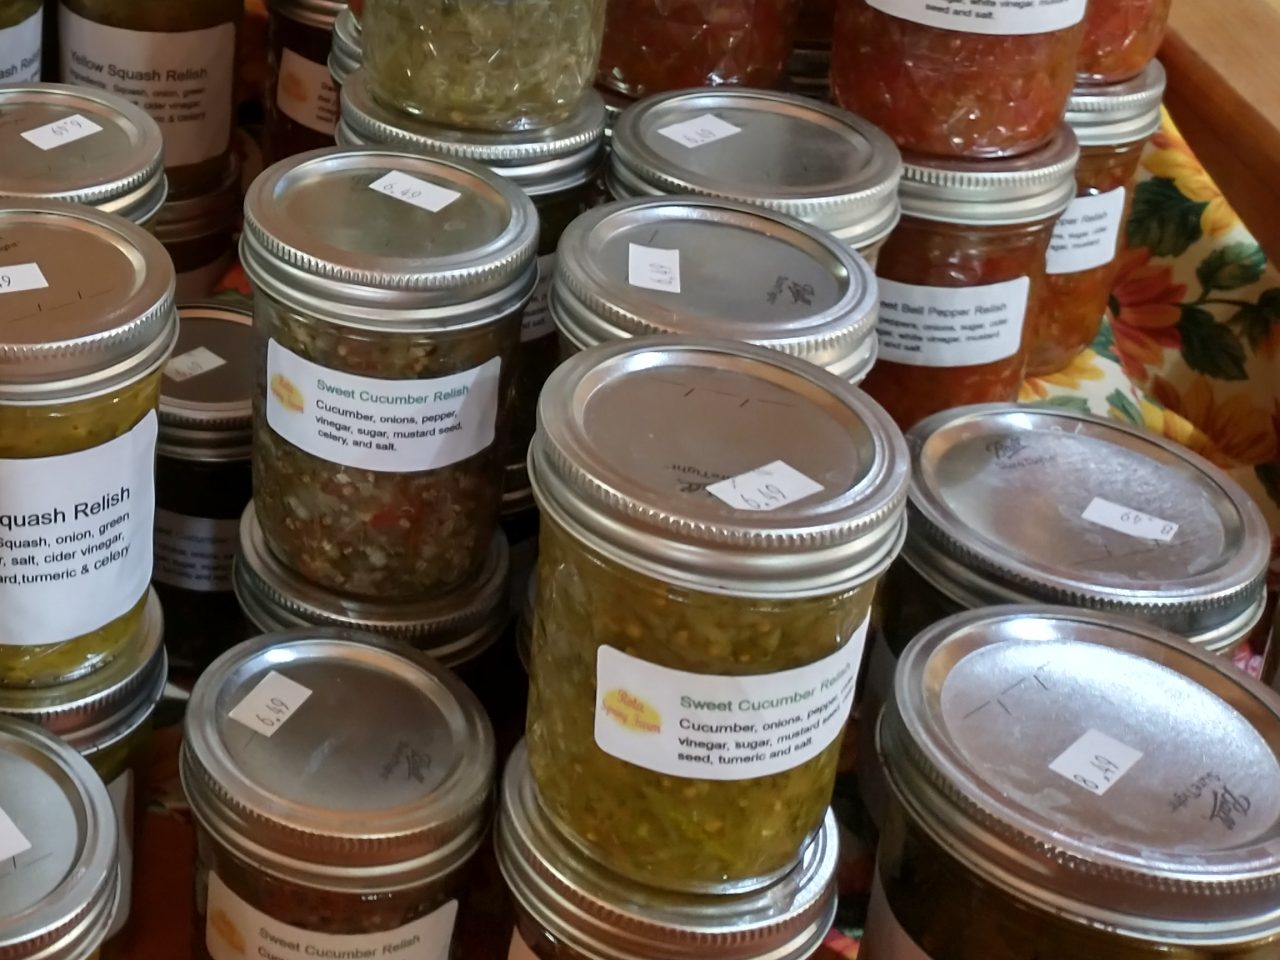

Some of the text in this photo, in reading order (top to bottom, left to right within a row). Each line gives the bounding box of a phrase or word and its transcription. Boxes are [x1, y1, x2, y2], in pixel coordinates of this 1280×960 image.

[107, 65, 160, 82] Squash
[166, 67, 207, 82] Relish
[317, 379, 469, 405] Sweet Cucumber Relish
[316, 400, 457, 425] Cucumber, onions, pepper,
[315, 415, 462, 440] vinegar, sugar, mustard seed,
[318, 429, 397, 451] celery, and salt.
[74, 487, 130, 520] Relish
[56, 529, 94, 544] onion,
[99, 512, 129, 536] green
[12, 554, 39, 566] salt,
[44, 551, 76, 564] cider
[80, 533, 124, 556] vinegar,
[81, 565, 89, 575] &
[94, 543, 131, 571] celery
[680, 695, 733, 713] Sweet
[739, 687, 815, 711] Cucumber
[678, 721, 820, 752] vinegar, sugar, mustard
[679, 715, 802, 734] Cucumber, onions,
[678, 747, 791, 765] seed, tumeric and
[260, 928, 299, 951] Sweet
[305, 945, 376, 959] Cucumber
